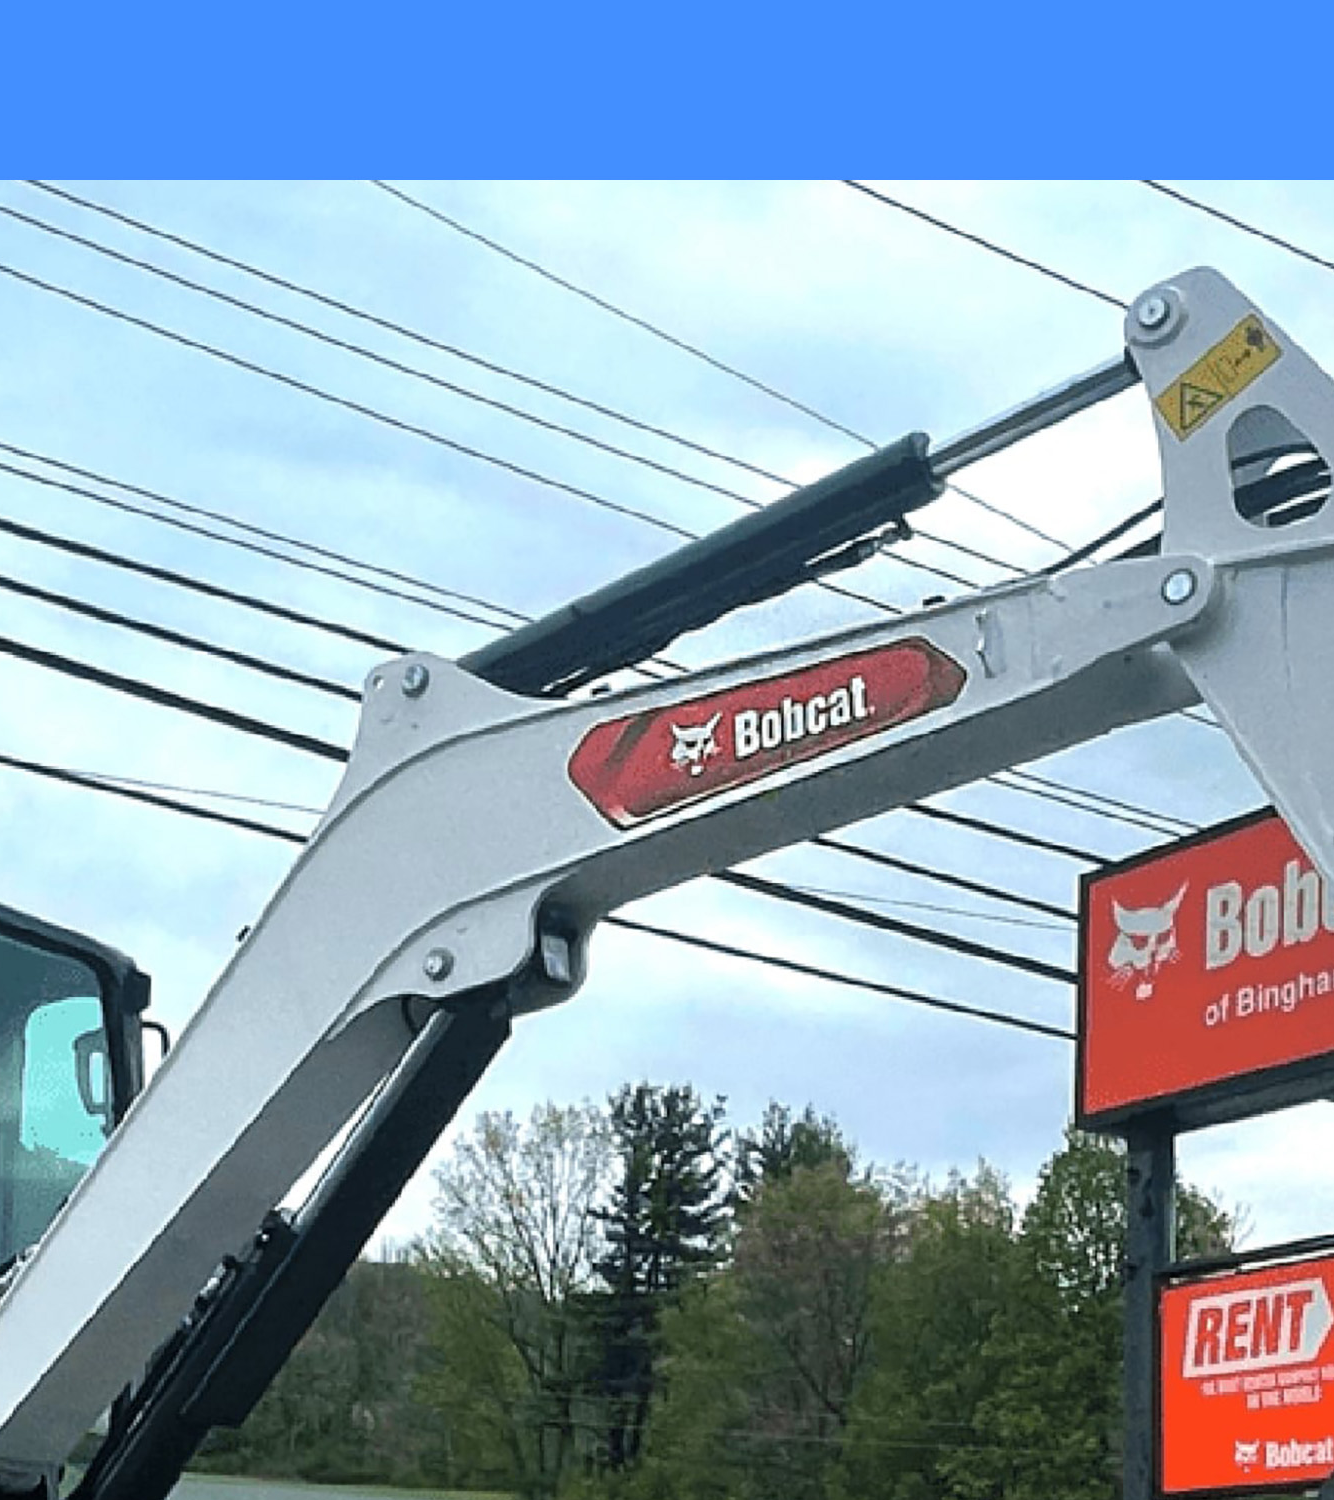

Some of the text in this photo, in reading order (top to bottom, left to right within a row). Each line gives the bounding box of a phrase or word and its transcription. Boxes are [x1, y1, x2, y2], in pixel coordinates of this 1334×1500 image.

[734, 675, 867, 758] Bobcat
[1205, 993, 1229, 1026] of
[1193, 1290, 1314, 1368] RENT
[1266, 1437, 1334, 1468] Bobcat
